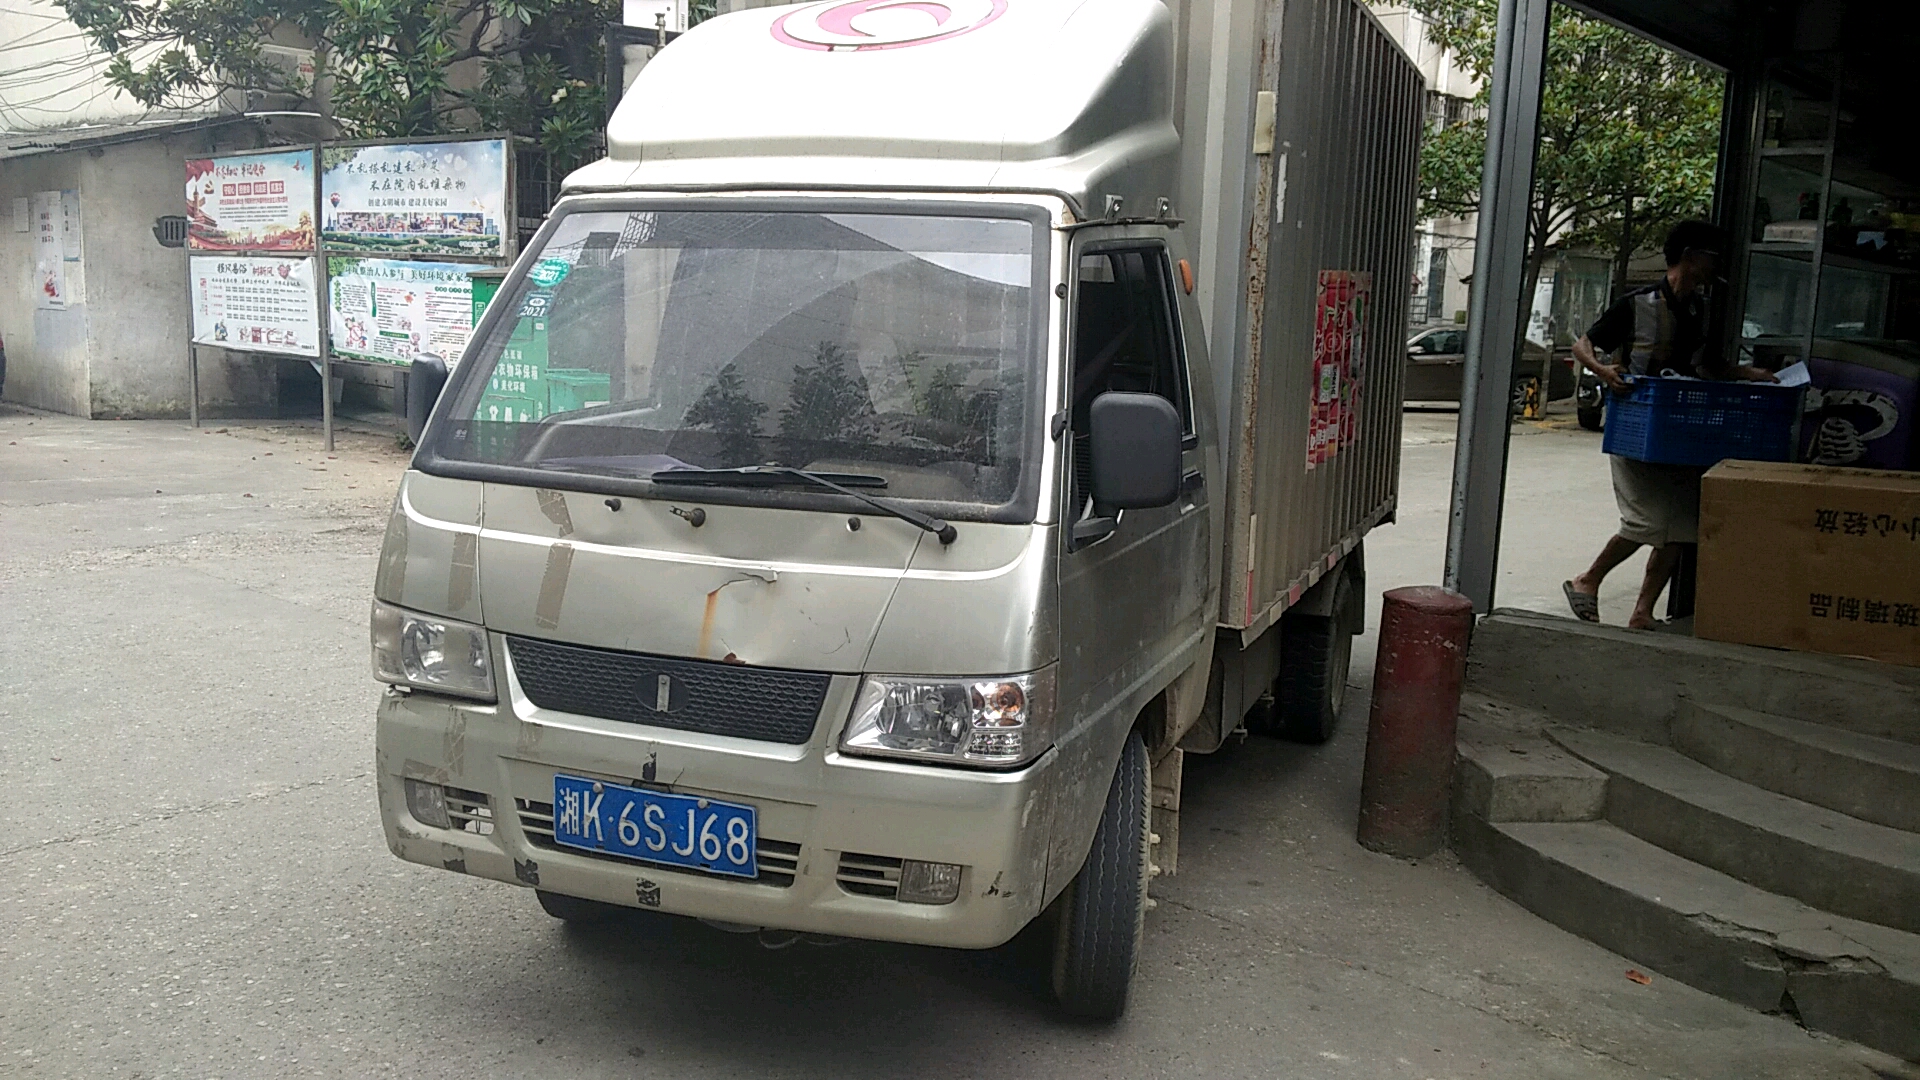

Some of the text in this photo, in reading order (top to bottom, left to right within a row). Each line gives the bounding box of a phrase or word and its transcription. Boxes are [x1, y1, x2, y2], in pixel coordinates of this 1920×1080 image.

[519, 306, 546, 317] 2021
[1809, 592, 1920, 627] 玻璃制品
